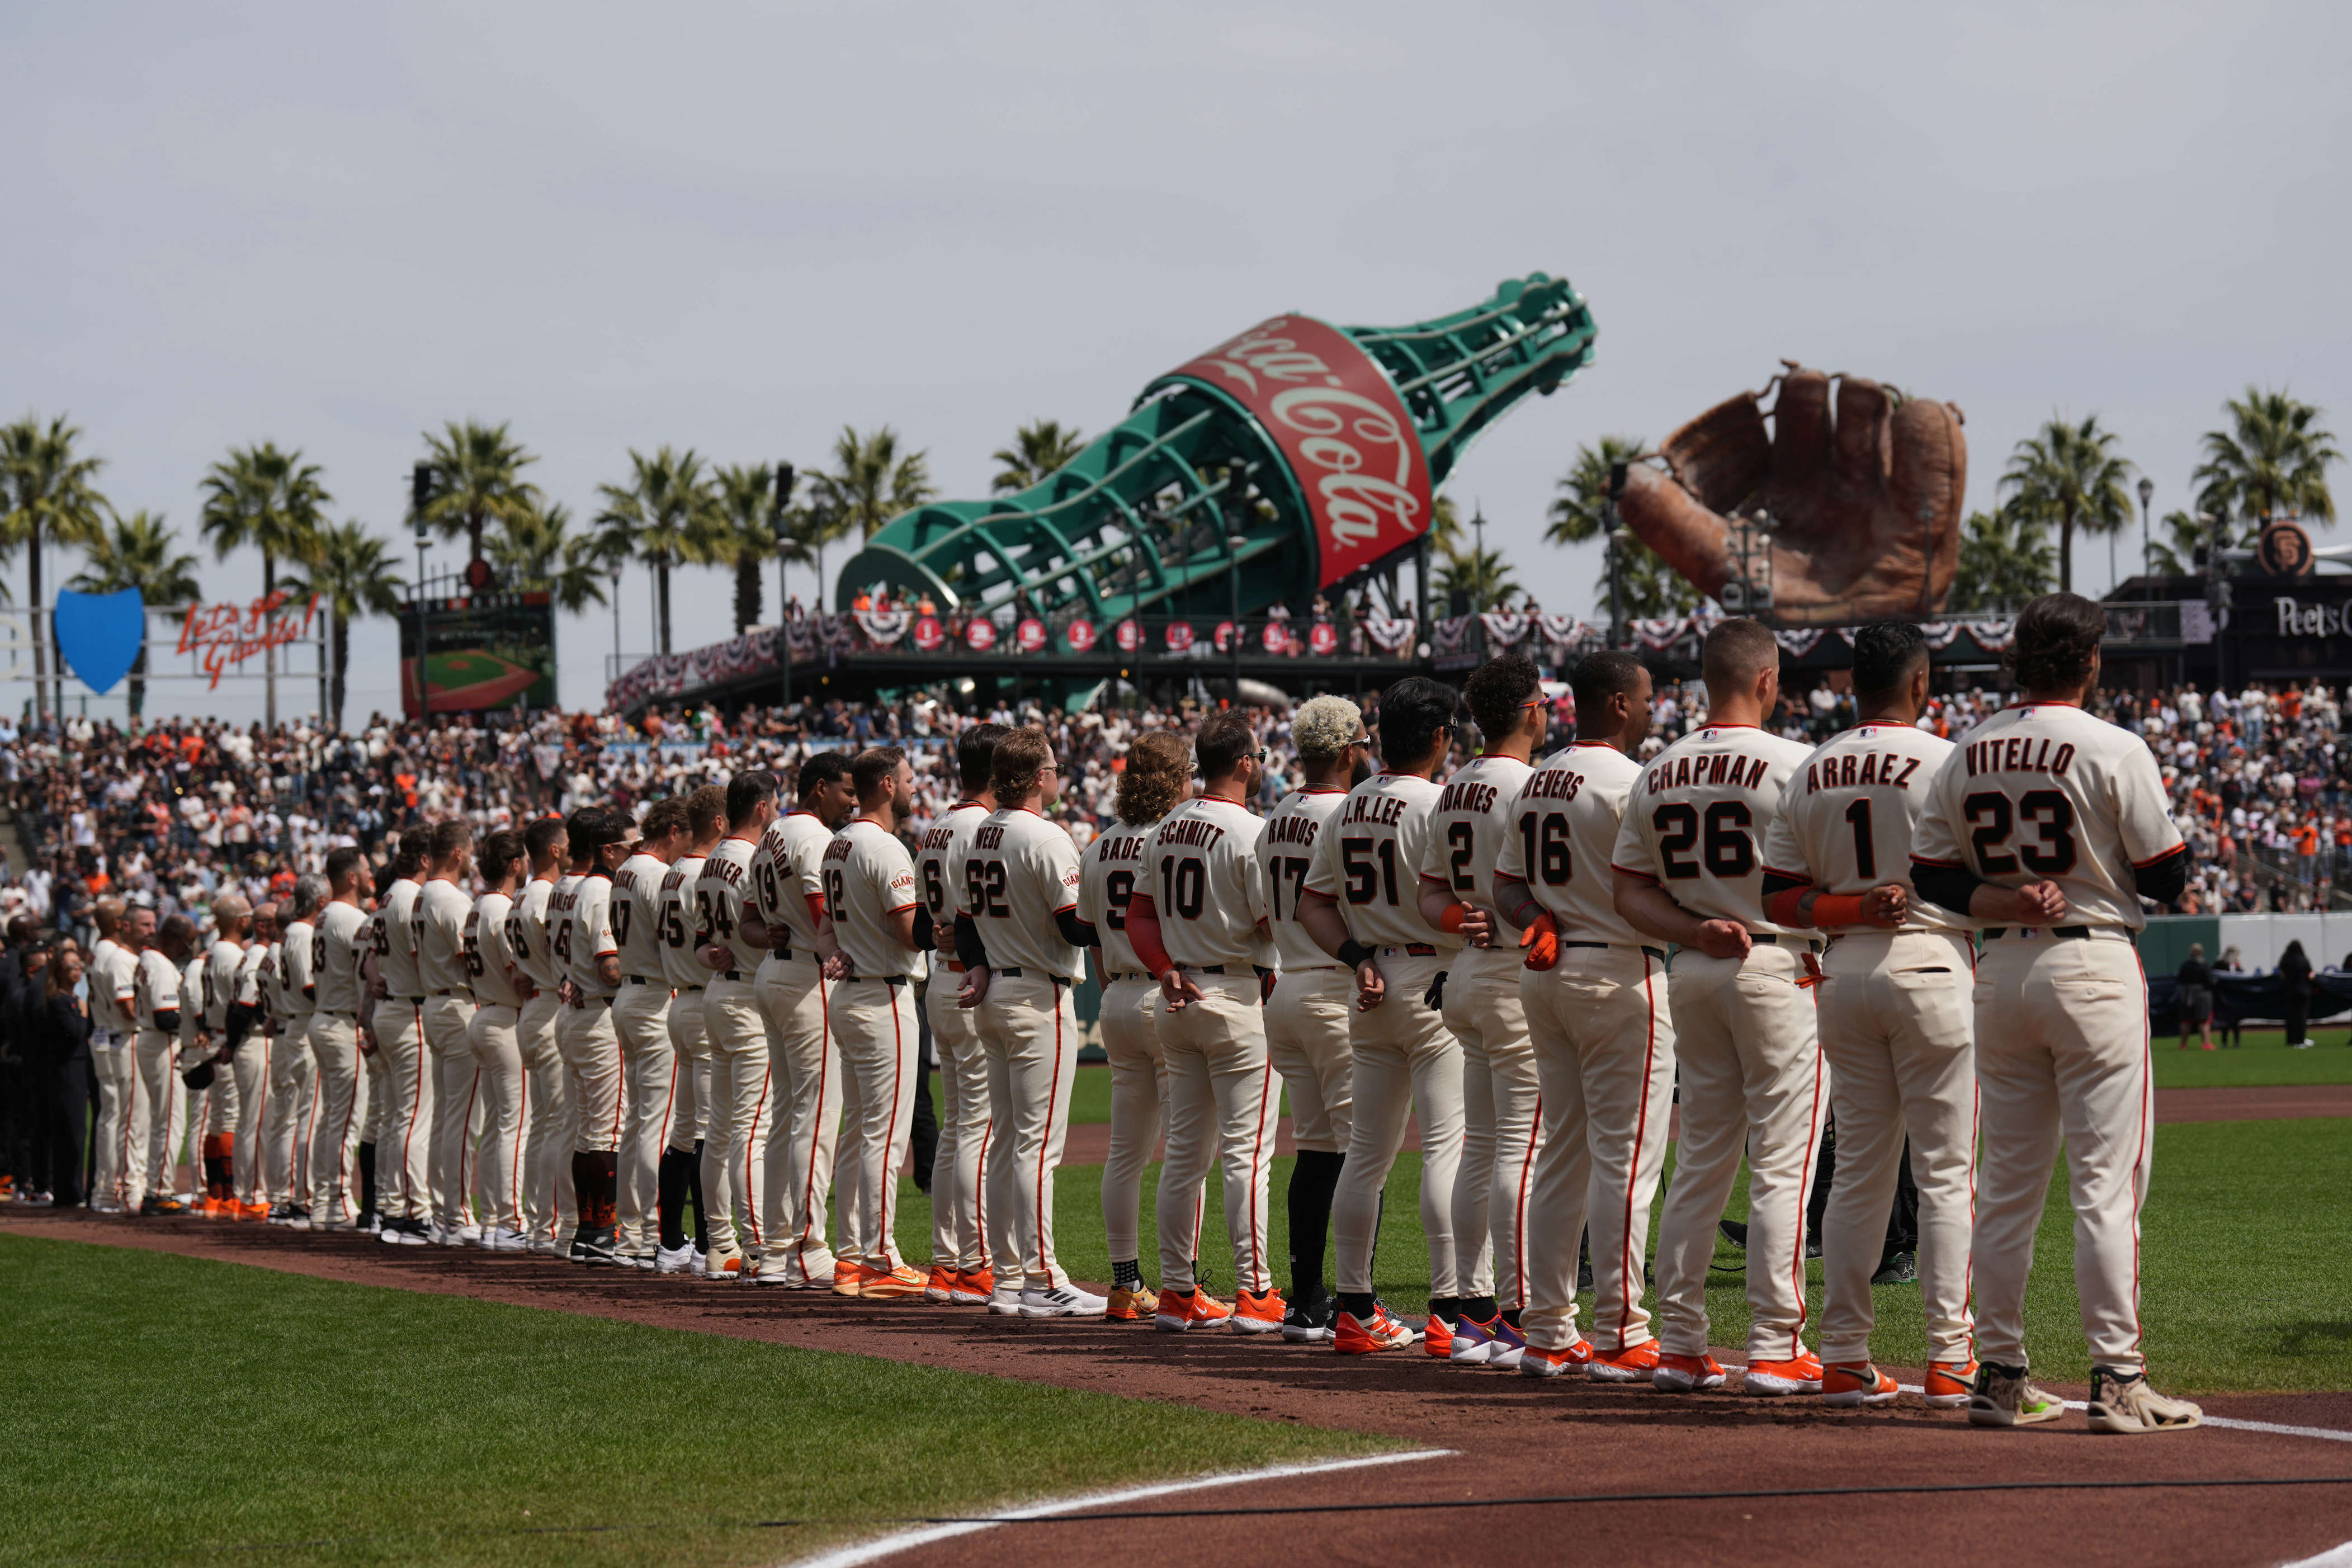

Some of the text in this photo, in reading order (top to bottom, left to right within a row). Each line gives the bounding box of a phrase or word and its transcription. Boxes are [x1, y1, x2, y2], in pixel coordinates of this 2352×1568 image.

[175, 590, 288, 654] Let's go
[2274, 596, 2340, 637] Peet's
[203, 593, 320, 691] Giants!
[1648, 755, 1769, 795] CHAPMAN
[1807, 753, 1921, 796] ARRAEZ
[1966, 738, 2075, 777] VITELLO
[1438, 782, 1498, 817] ADAMES
[1521, 769, 1584, 802] DEVERS
[1157, 820, 1225, 852] SCHMITT
[1268, 816, 1318, 847] RAMOS
[1342, 796, 1408, 829] J.H.LEE
[1963, 790, 2077, 875] 23
[920, 829, 953, 851] USAC
[976, 826, 1004, 851] WEBB
[1099, 837, 1145, 862] BADE
[1448, 821, 1475, 891] 2
[1519, 811, 1572, 886] 16
[1652, 800, 1755, 880] 26
[1845, 798, 1876, 879] 1
[700, 858, 743, 886] UBAKER
[755, 862, 778, 914] 19
[824, 869, 847, 922] 12
[891, 876, 915, 889] GIANT
[923, 859, 943, 914] 6
[966, 859, 1010, 918] 62
[1161, 855, 1205, 920] 10
[1269, 856, 1310, 922] 17
[1342, 837, 1400, 907] 51
[610, 900, 631, 946] 47
[658, 900, 686, 948] 45
[698, 890, 734, 940] 34
[1106, 870, 1136, 931] 9
[739, 1266, 750, 1276] 34
